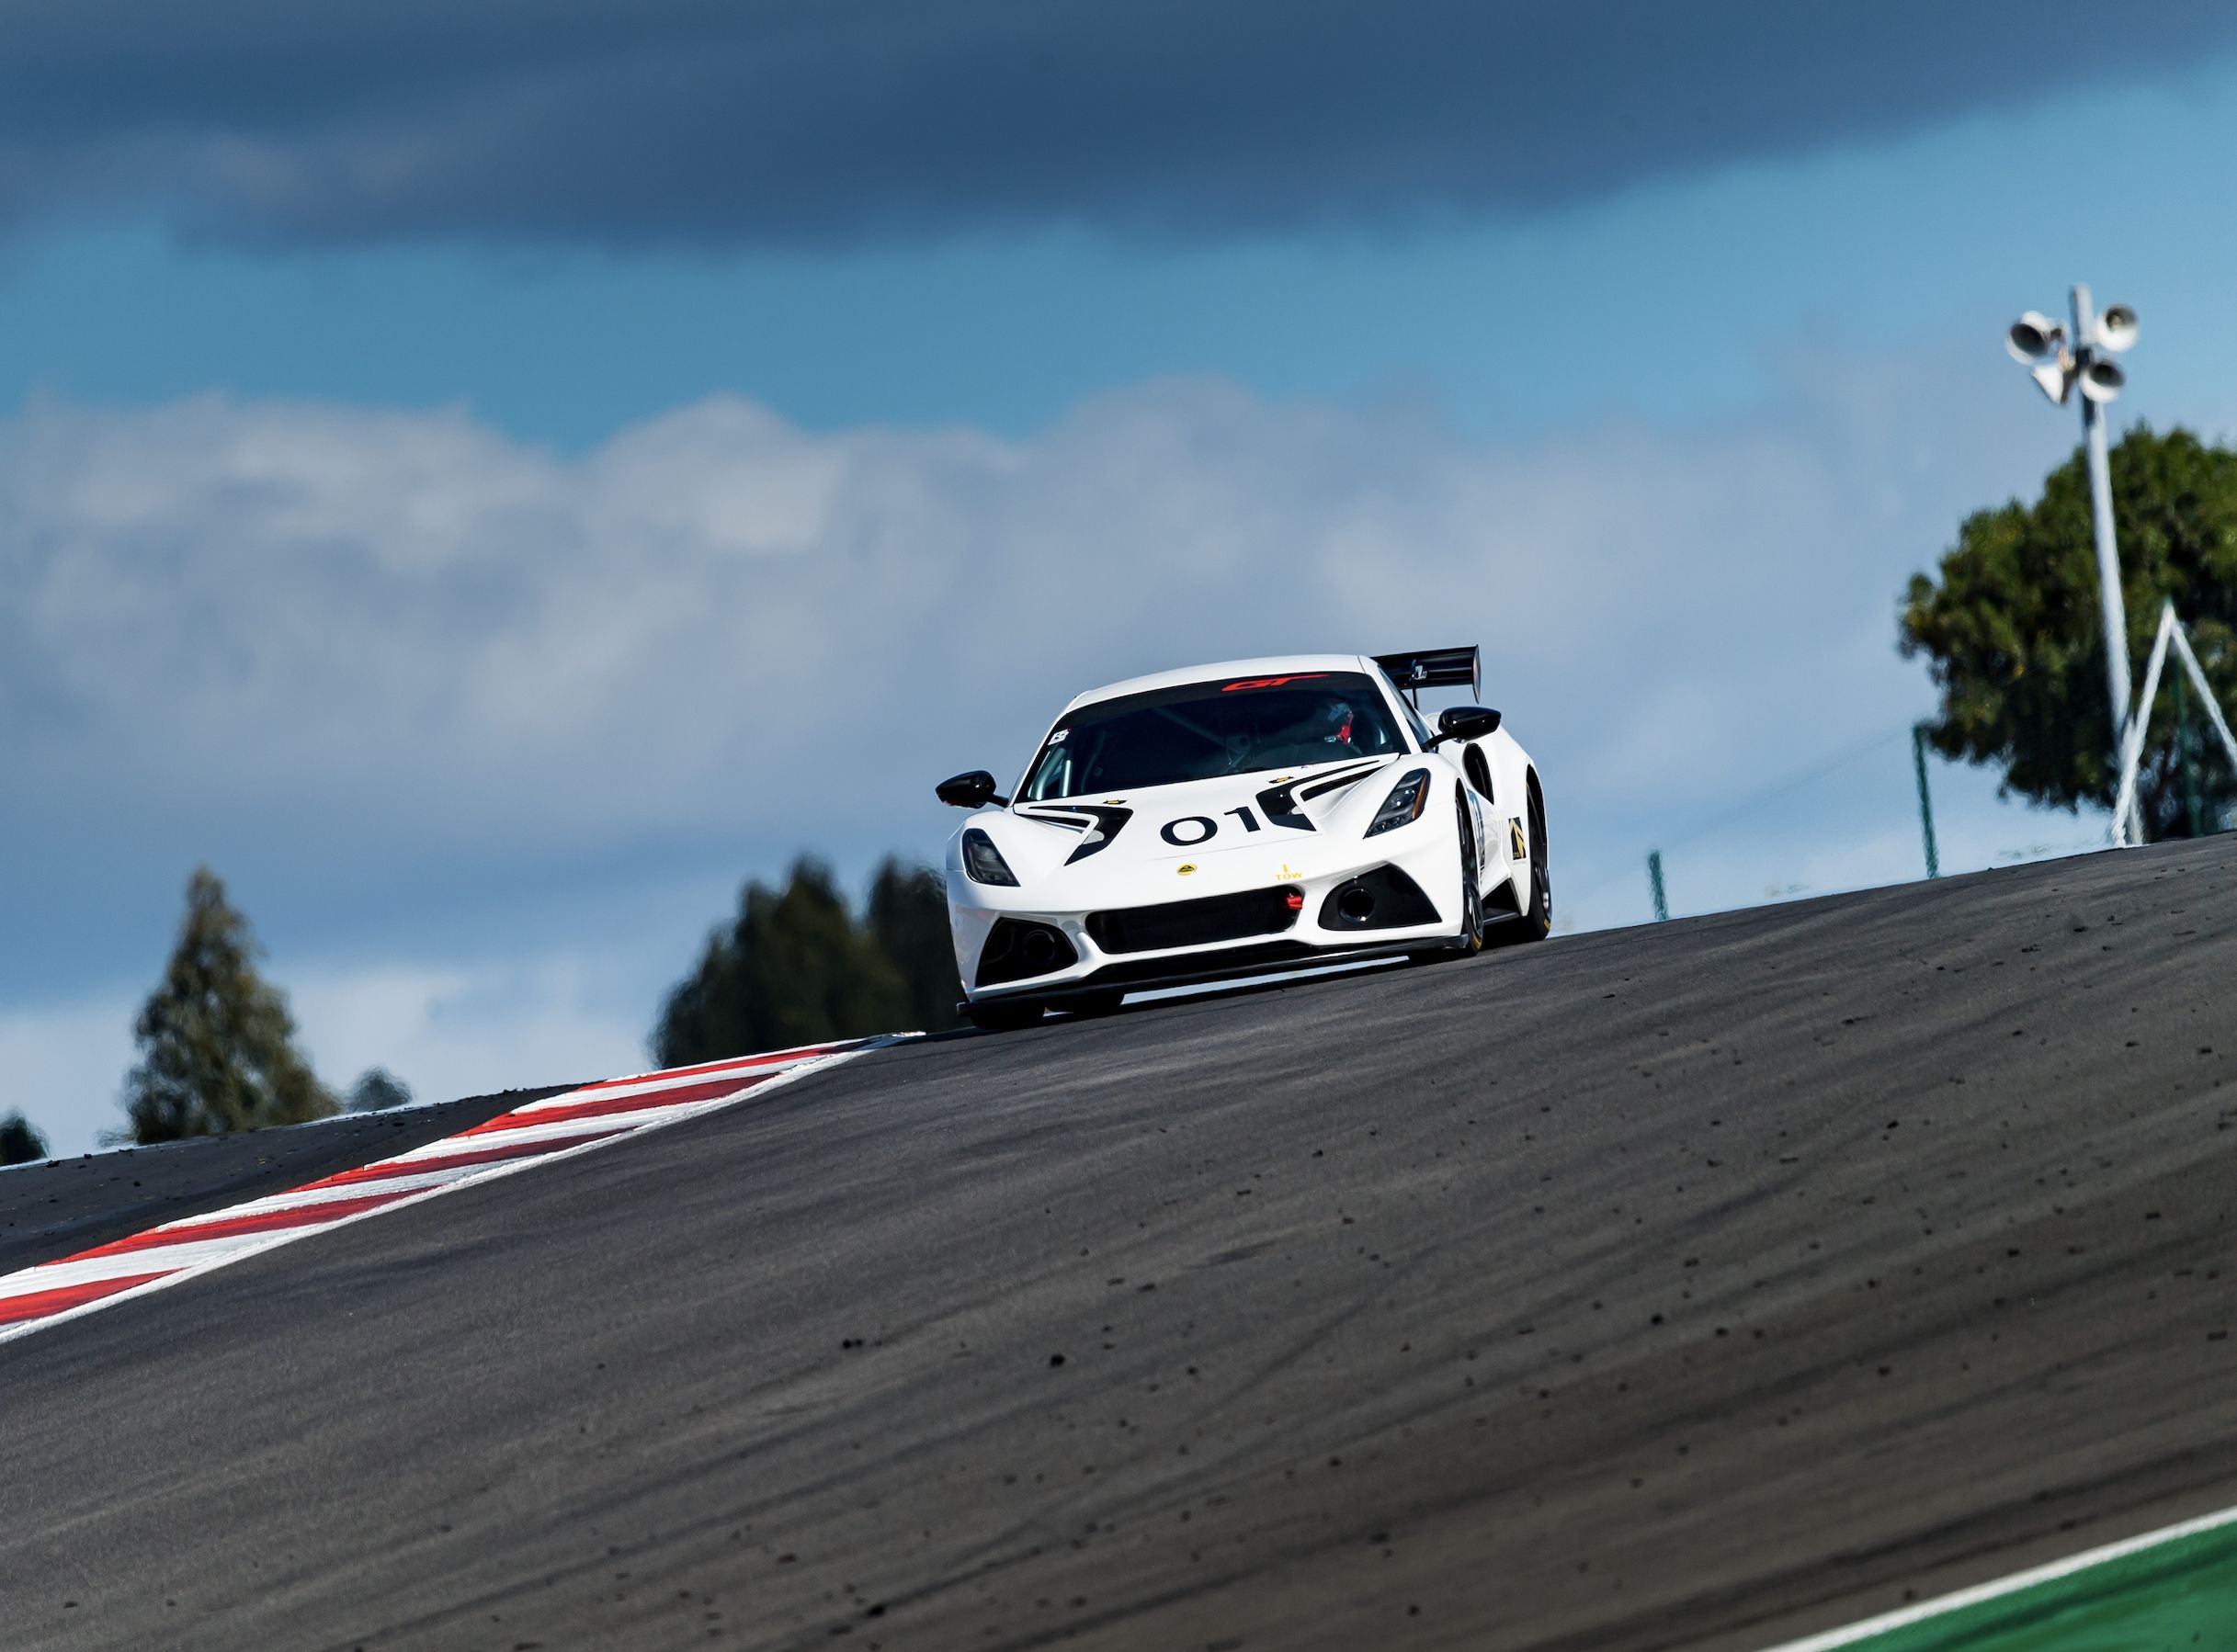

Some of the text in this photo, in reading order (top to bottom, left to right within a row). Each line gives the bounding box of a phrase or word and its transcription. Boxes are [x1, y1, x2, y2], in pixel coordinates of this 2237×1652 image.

[1221, 673, 1330, 692] GT
[1160, 806, 1261, 846] 01
[1275, 872, 1302, 881] TOW
